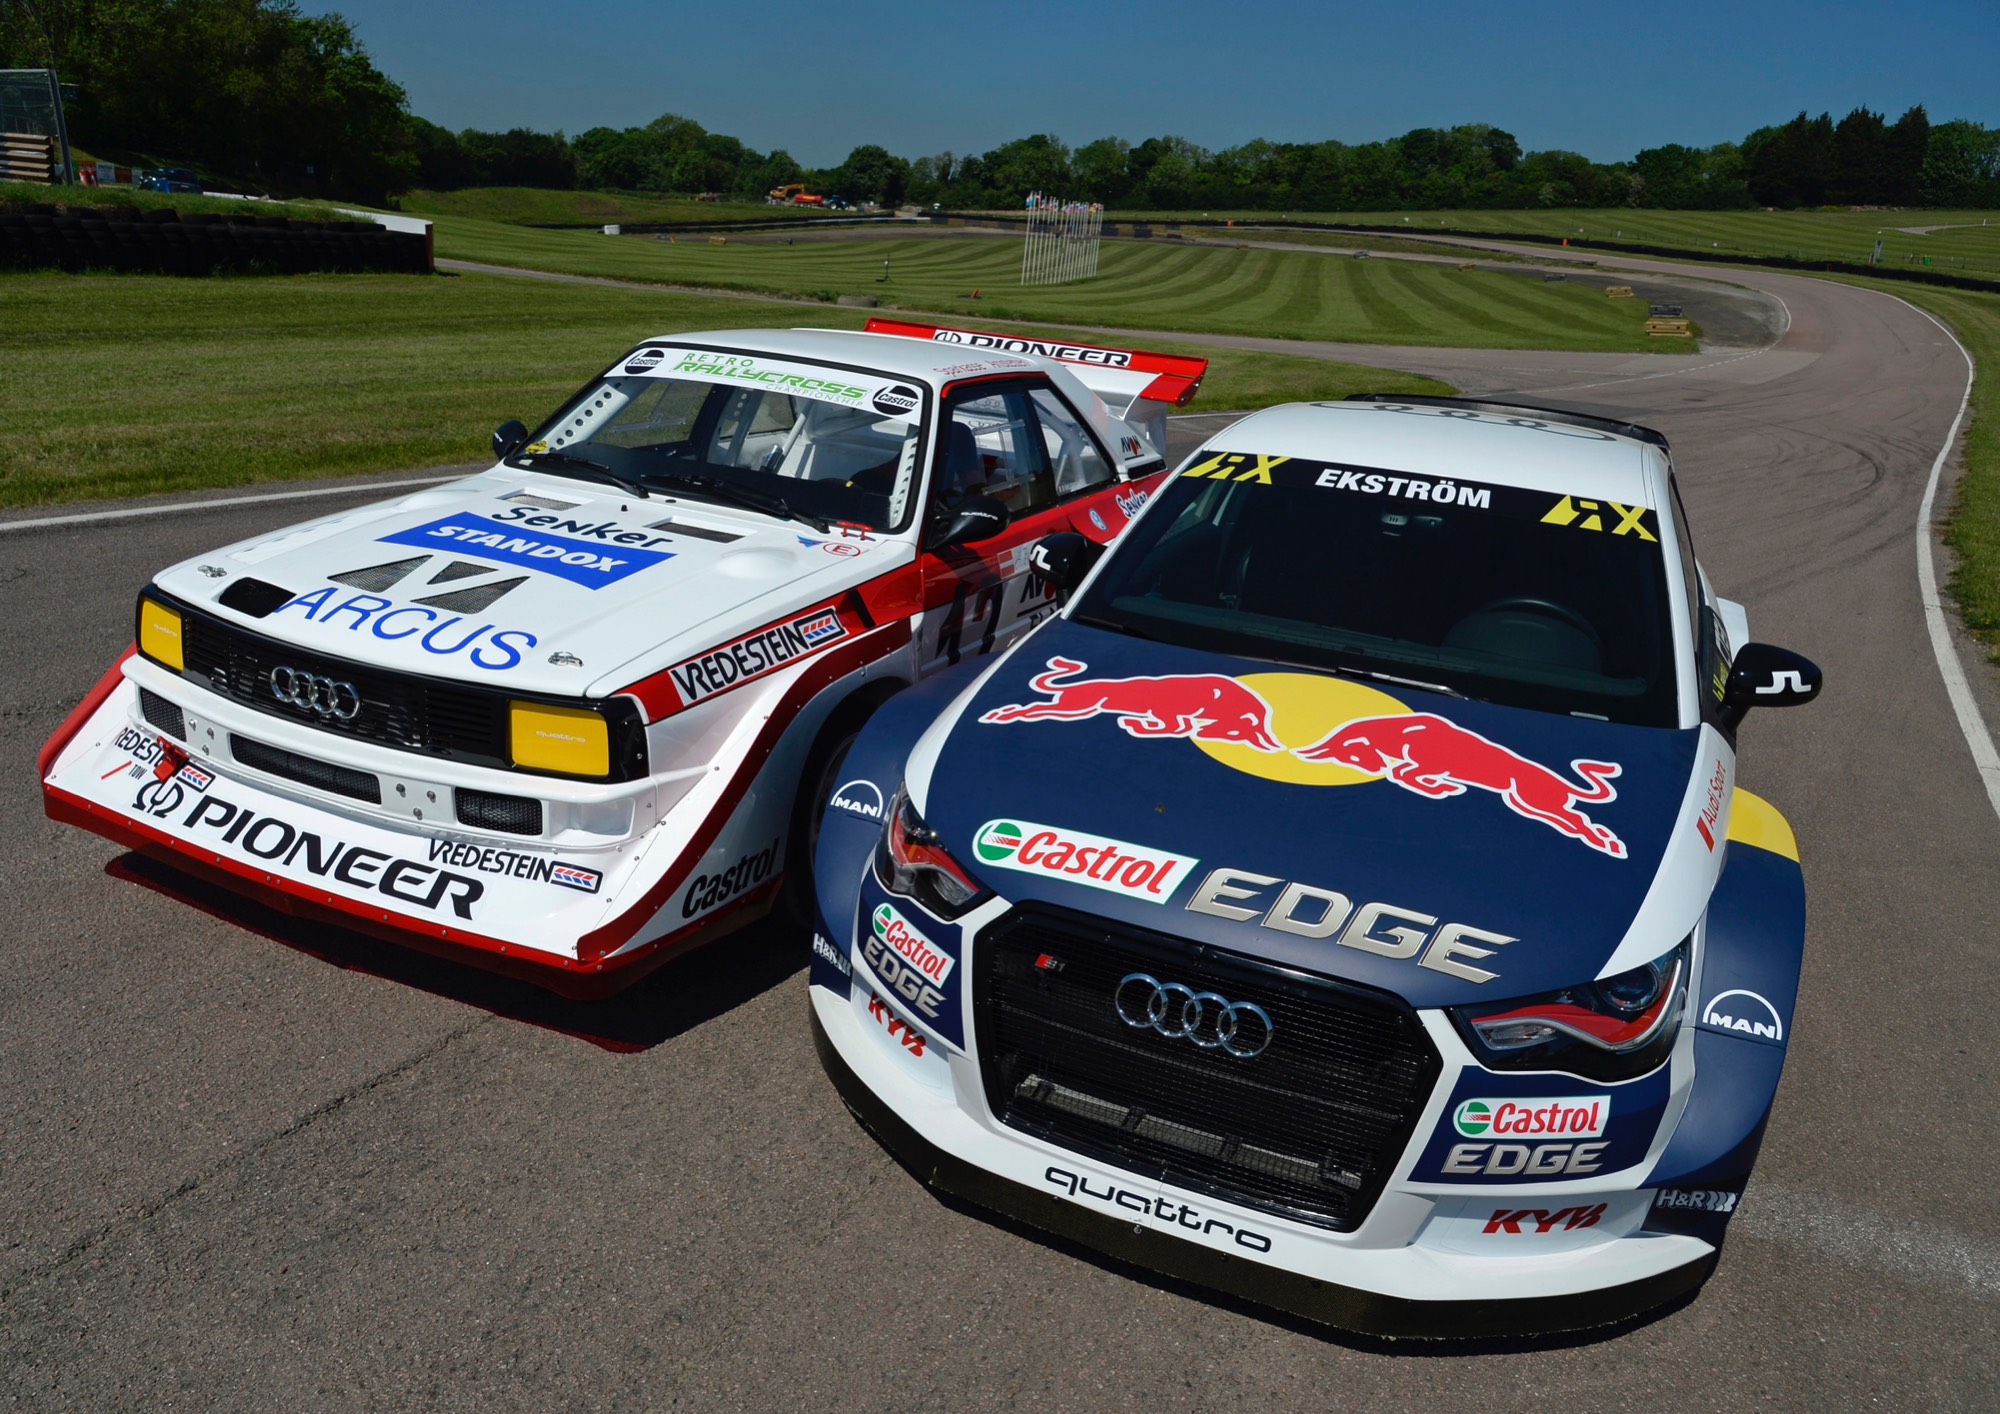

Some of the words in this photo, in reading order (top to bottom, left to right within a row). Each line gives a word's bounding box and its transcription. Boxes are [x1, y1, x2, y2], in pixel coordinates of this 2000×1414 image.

[629, 356, 663, 367] Castrol
[684, 352, 754, 367] RETRO
[969, 335, 1131, 367] PIONEER
[672, 361, 871, 399] RALLYCROSS
[765, 383, 864, 407] CHAMPIONSHIP
[878, 392, 918, 409] Castrol
[1315, 468, 1492, 509] EKSTRÖM
[426, 526, 630, 573] STANDOX
[273, 587, 538, 671] ARCUS
[670, 622, 811, 700] VREDESTEIN
[128, 763, 148, 780] TOW
[834, 797, 879, 818] MAN
[1702, 788, 1721, 831] Audi
[182, 793, 484, 922] PIONEER
[428, 838, 552, 883] VREDESTEIN
[681, 836, 780, 919] Castrol
[1016, 830, 1178, 896] Castrol
[1185, 866, 1521, 985] EDGE
[885, 920, 949, 982] Castrol
[863, 935, 948, 1019] EDGE
[868, 990, 928, 1058] KYB
[1709, 1011, 1776, 1039] MAN
[1492, 1101, 1600, 1134] Castrol
[1440, 1140, 1612, 1175] EDGE
[1045, 1166, 1272, 1253] quattro
[1481, 1202, 1608, 1234] KYB
